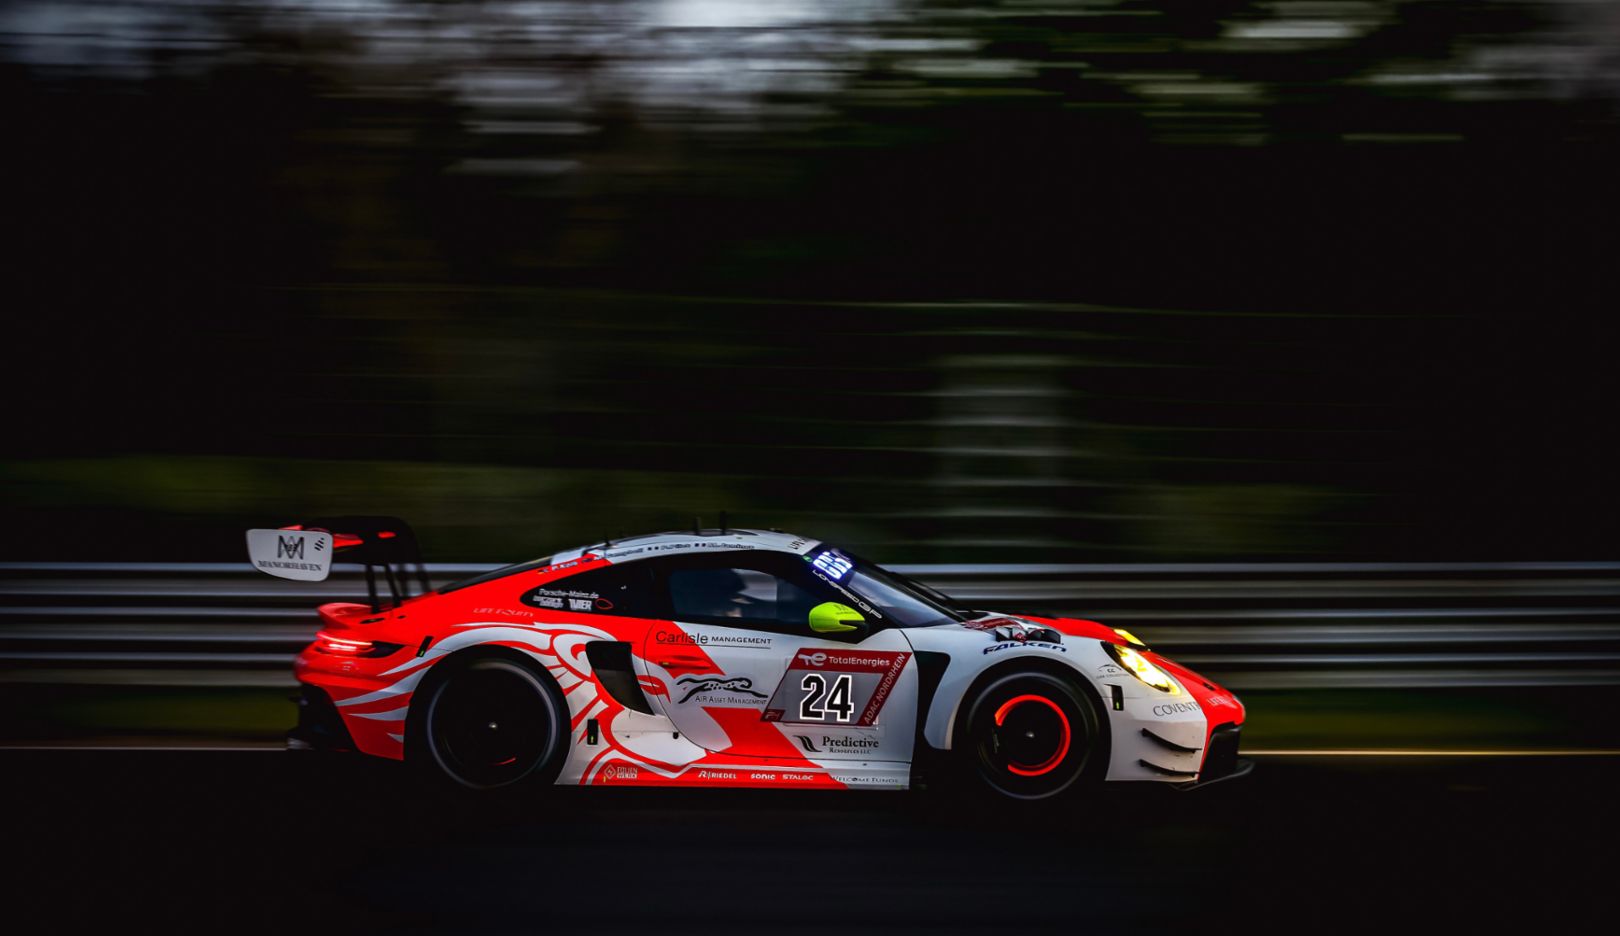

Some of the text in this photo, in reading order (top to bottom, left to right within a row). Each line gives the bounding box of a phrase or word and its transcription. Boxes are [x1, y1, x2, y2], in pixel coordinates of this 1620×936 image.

[258, 560, 322, 571] MANORHAVEN
[858, 601, 883, 619] GP
[655, 631, 772, 645] Carlisle MANAGEMENT
[982, 642, 1067, 656] FALKEN
[828, 656, 891, 668] TotalEnergies
[863, 652, 907, 725] ADAC NORDRHEIN
[799, 673, 855, 722] 24
[821, 735, 880, 749] Predictive
[711, 772, 737, 780] RIEDEL
